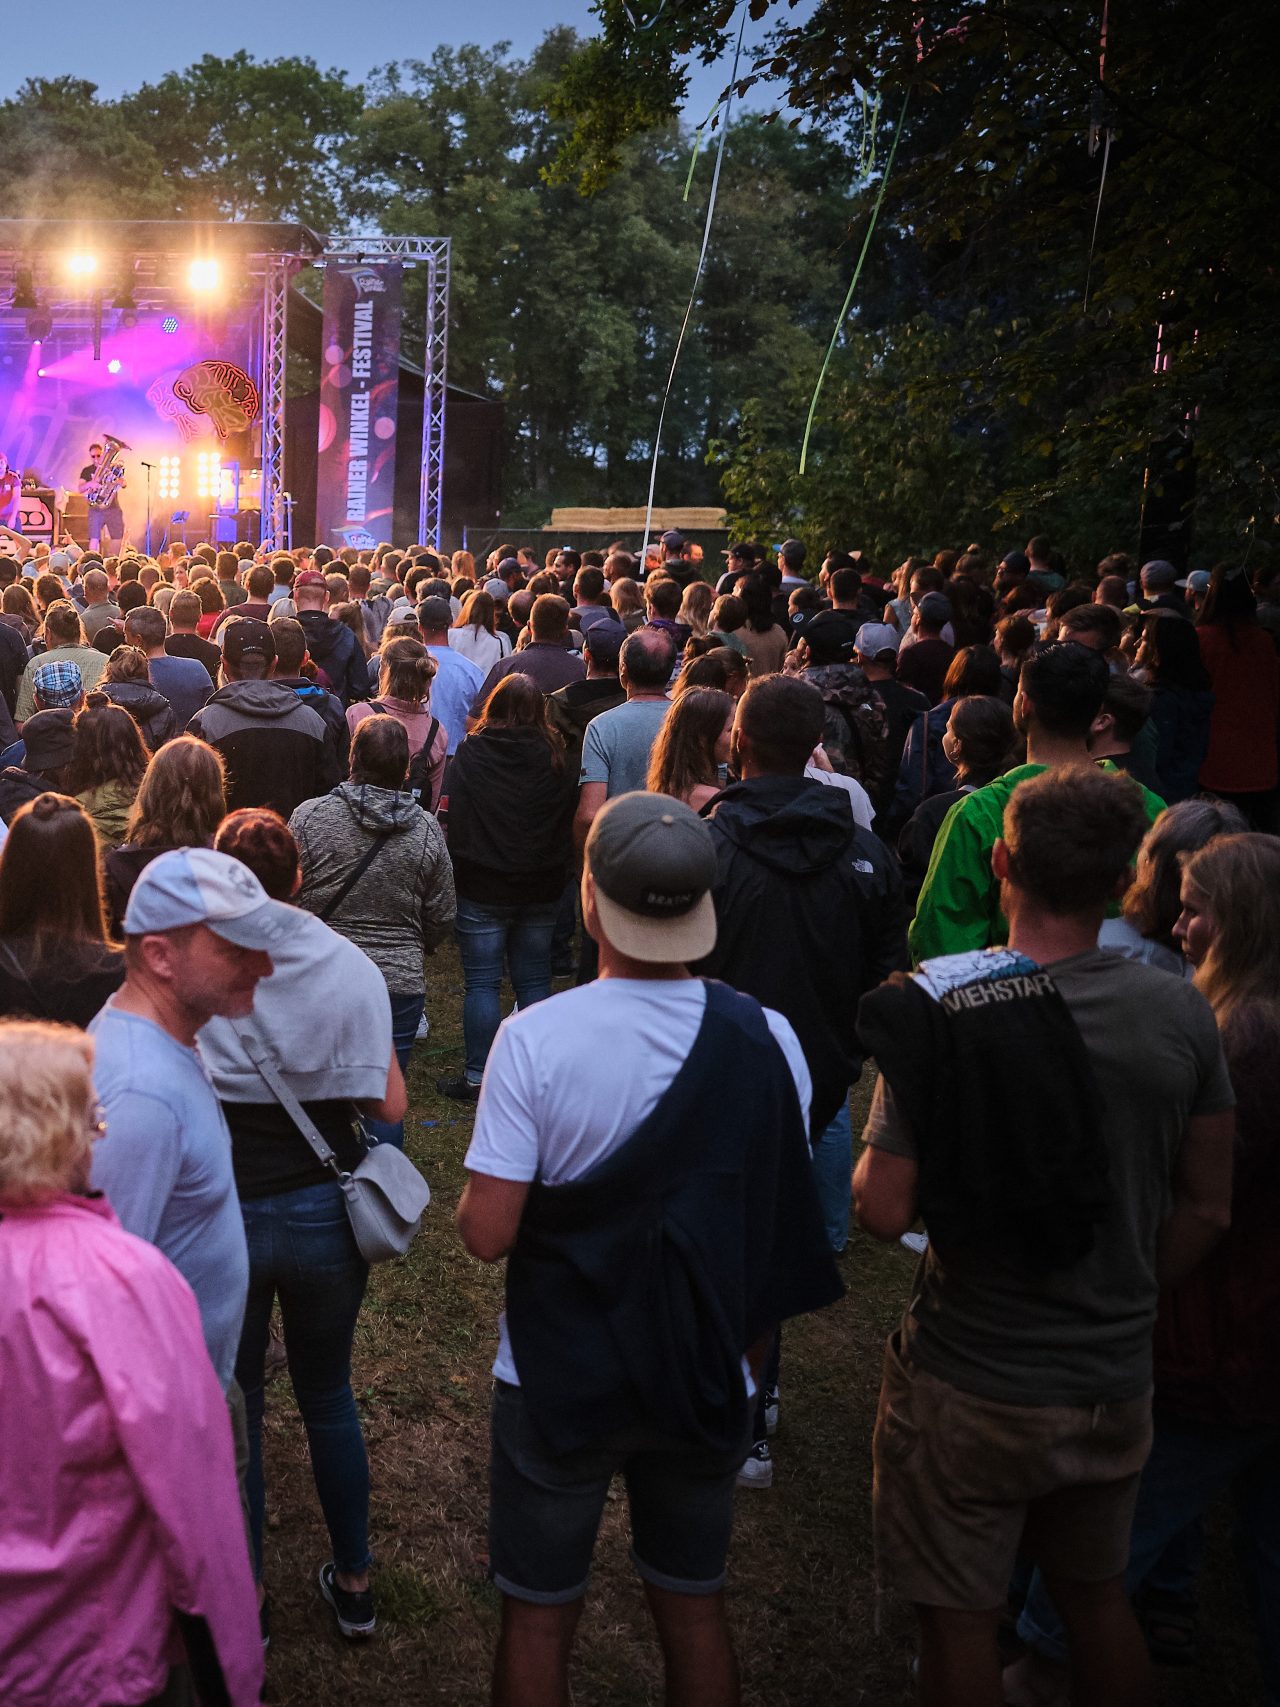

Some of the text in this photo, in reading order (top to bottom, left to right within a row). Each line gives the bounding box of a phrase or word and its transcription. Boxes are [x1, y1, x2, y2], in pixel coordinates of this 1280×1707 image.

[352, 300, 373, 378] FESTIVAL
[349, 391, 370, 457] WINKEL
[347, 460, 368, 521] RAINER
